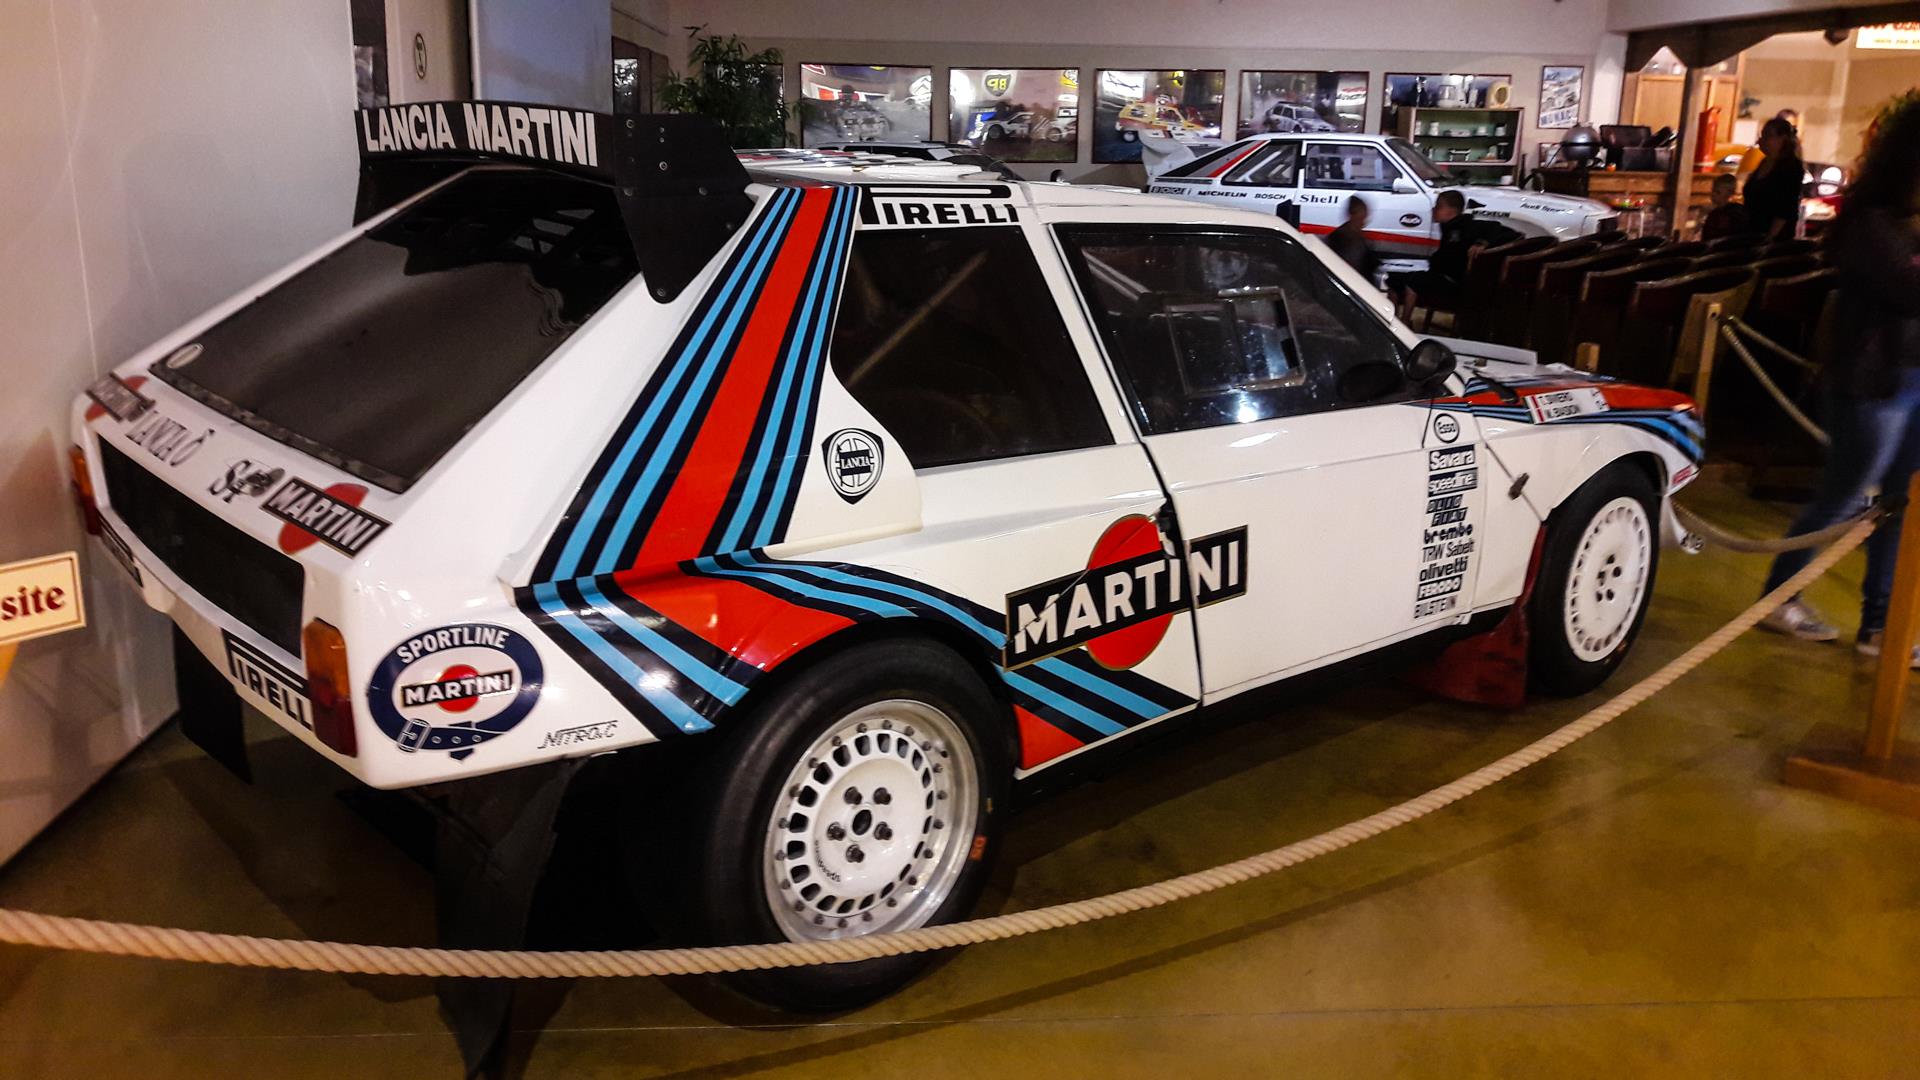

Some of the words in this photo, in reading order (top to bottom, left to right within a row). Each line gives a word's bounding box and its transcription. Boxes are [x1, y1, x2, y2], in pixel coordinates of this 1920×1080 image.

[362, 103, 456, 152] LANCIA
[463, 102, 598, 167] MARTINI
[859, 184, 1019, 224] PIRELLI
[1198, 190, 1247, 198] MICHELIN
[1299, 193, 1338, 204] Shell
[841, 456, 871, 469] LANCIA
[1430, 450, 1474, 470] Savara
[268, 482, 382, 551] MARTINI
[1424, 522, 1473, 544] brembo
[1420, 556, 1468, 581] olivetti
[1, 586, 65, 621] site
[1014, 540, 1239, 654] MARTINI
[398, 627, 511, 664] SPORTLINE
[221, 627, 313, 732] PIRELL
[404, 672, 511, 706] MARTINI
